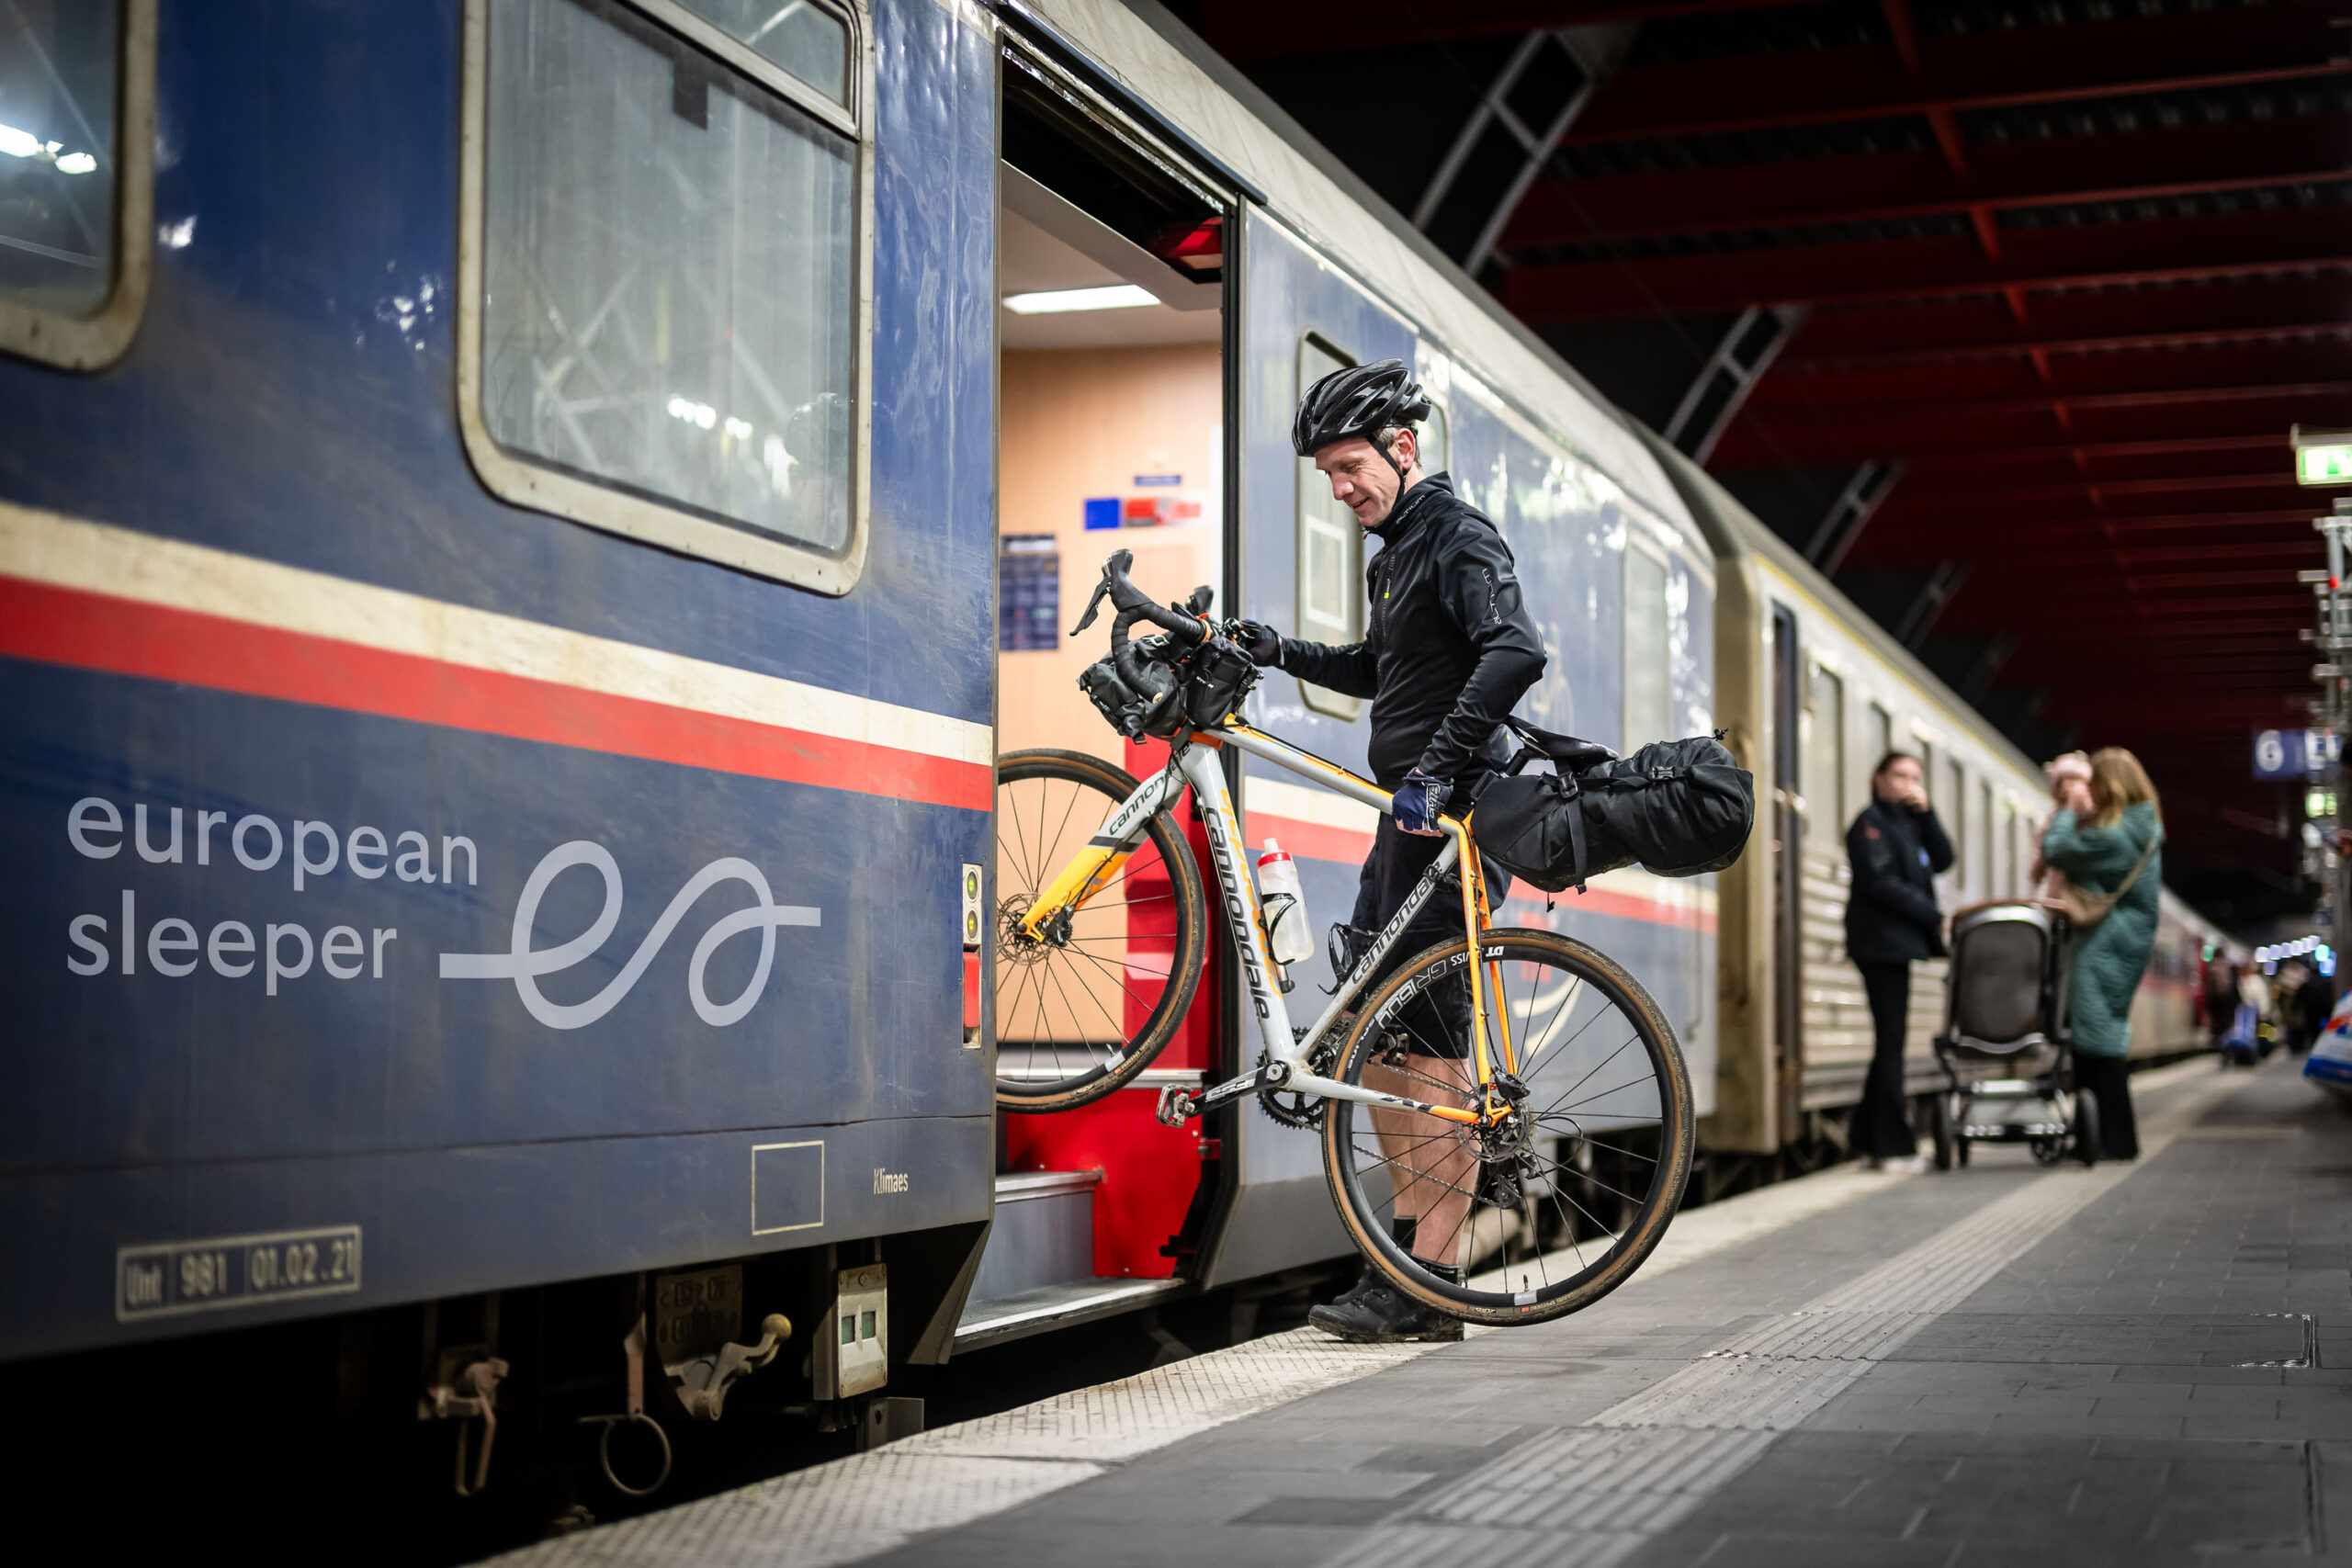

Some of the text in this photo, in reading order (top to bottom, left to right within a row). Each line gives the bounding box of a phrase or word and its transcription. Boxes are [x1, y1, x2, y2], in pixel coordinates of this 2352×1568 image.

[2255, 728, 2285, 773] 6
[66, 793, 479, 892] european
[66, 888, 397, 997] sleeper
[1205, 806, 1272, 1021] cannondale
[1485, 945, 1505, 957] DT
